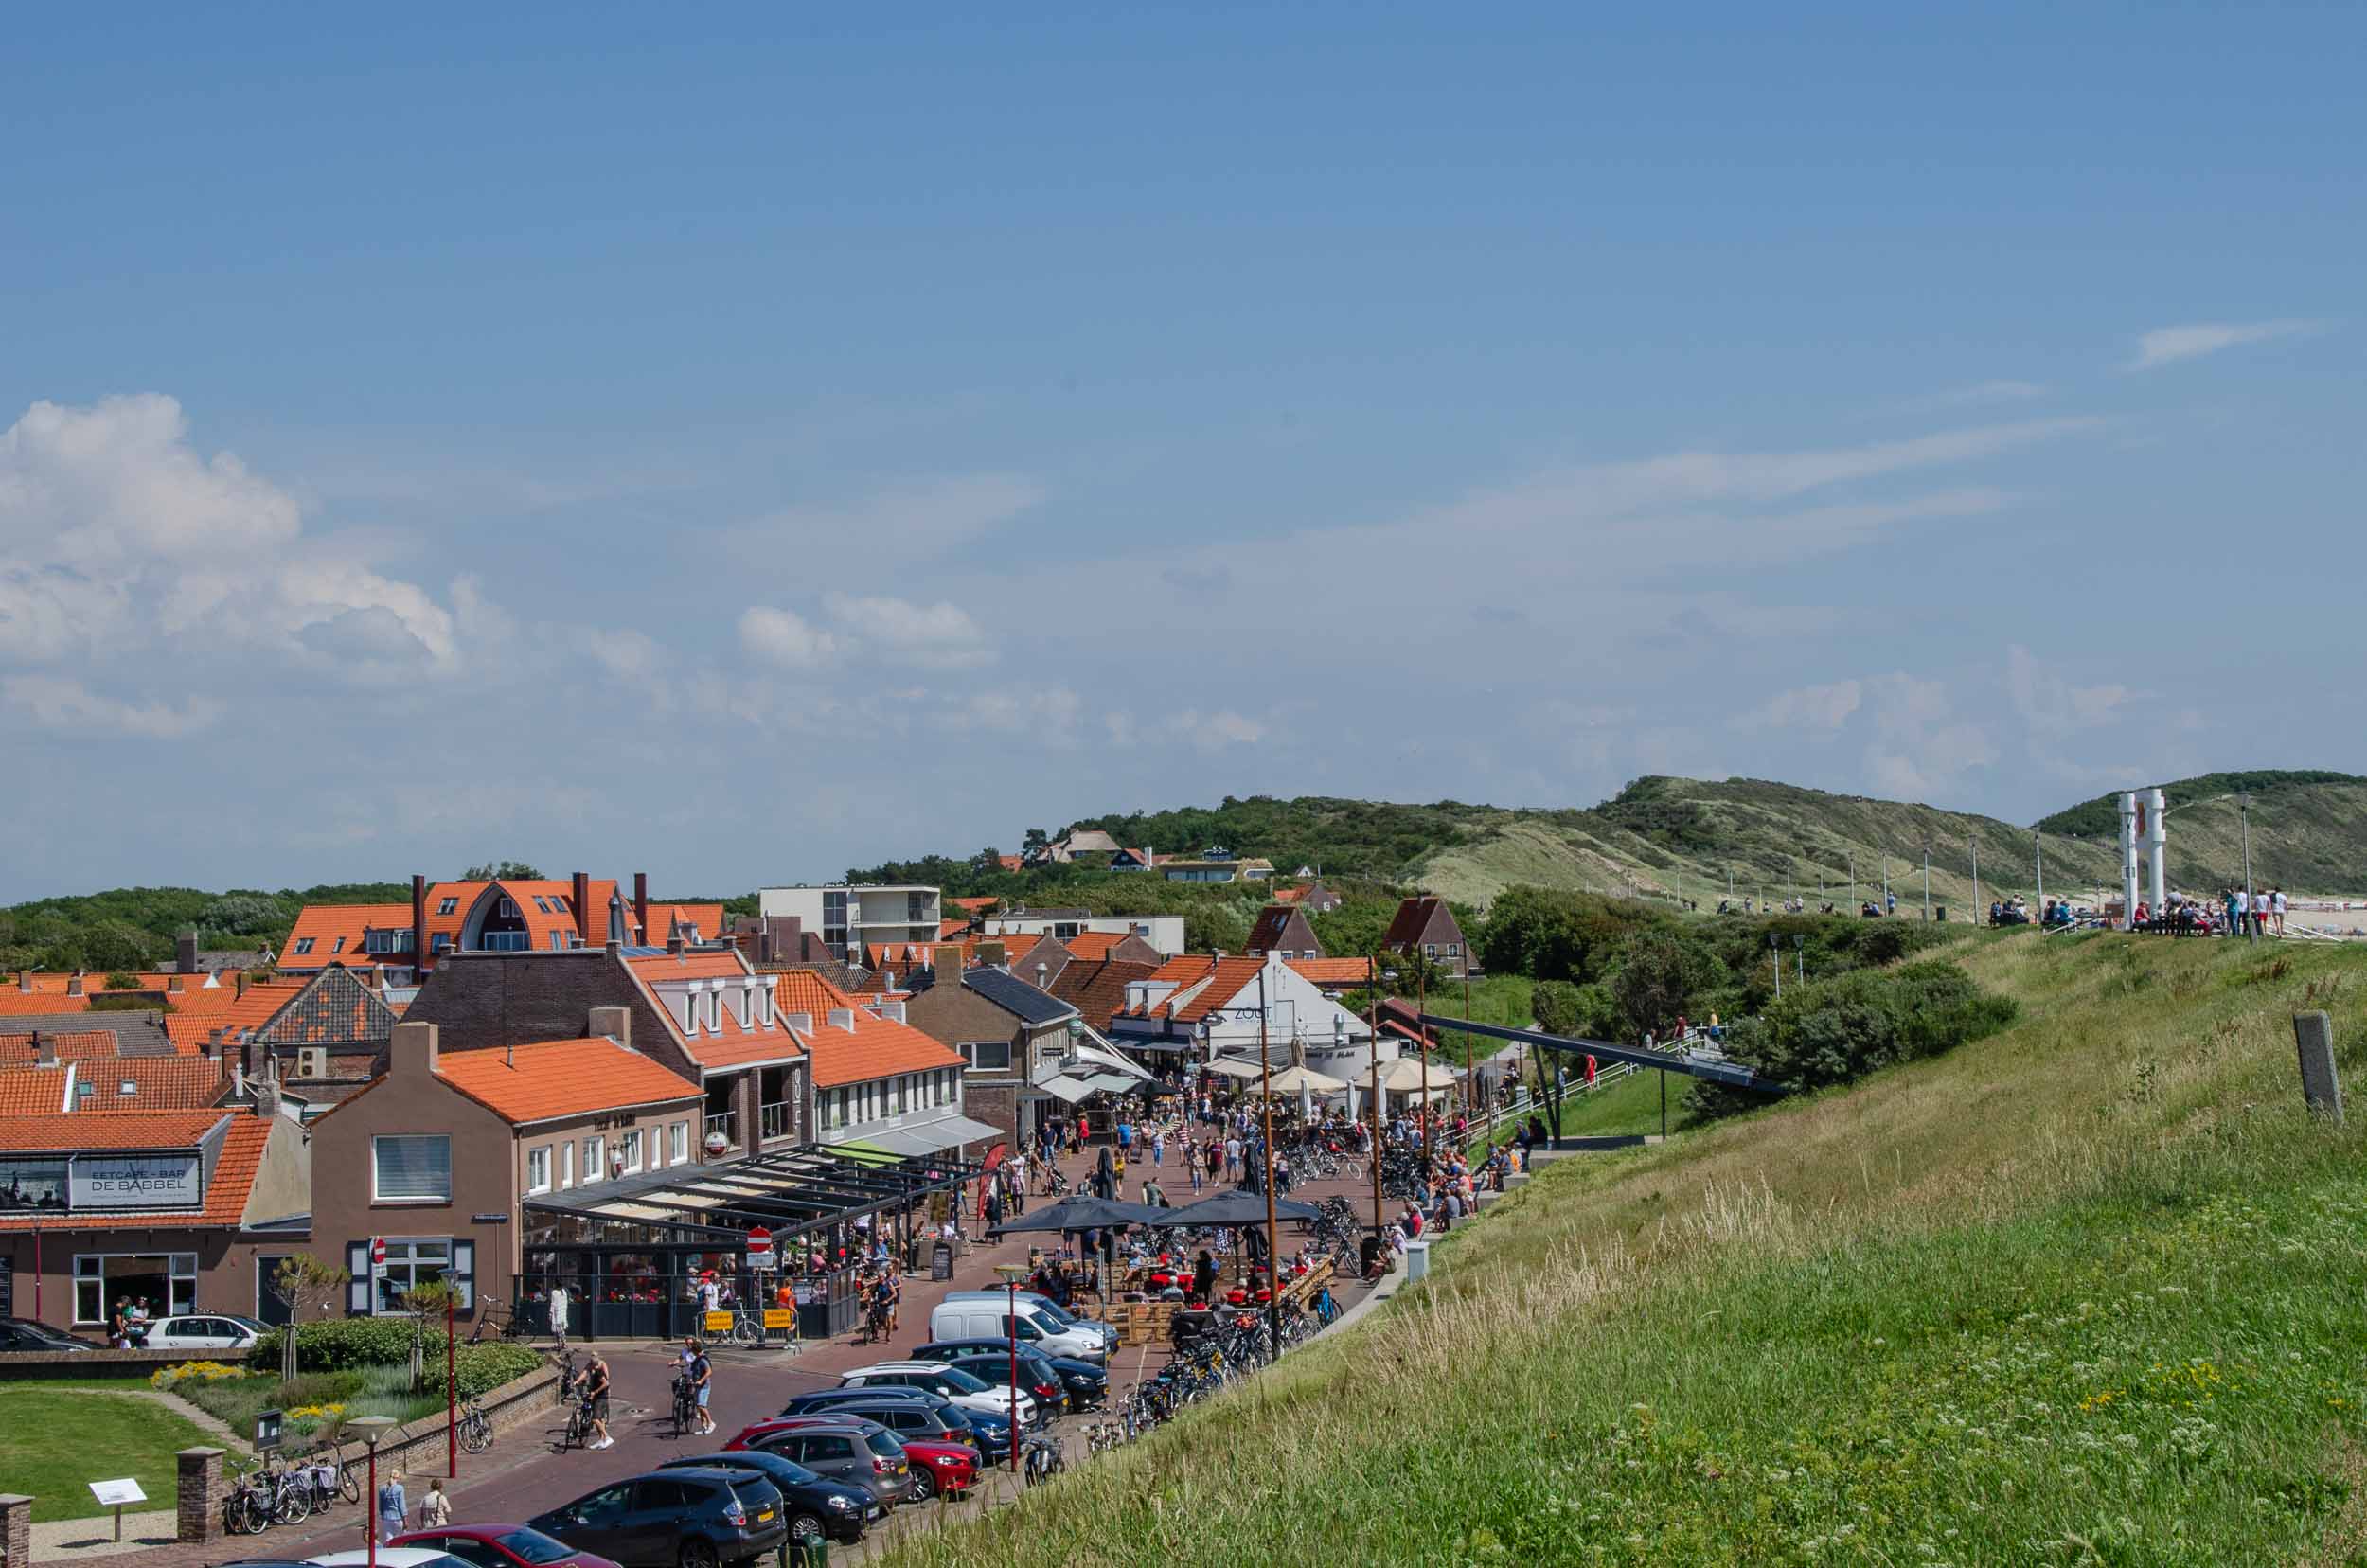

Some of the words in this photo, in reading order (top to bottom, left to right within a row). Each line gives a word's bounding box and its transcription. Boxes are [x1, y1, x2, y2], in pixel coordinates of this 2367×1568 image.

[159, 1169, 186, 1179] BAR
[92, 1181, 115, 1191] DE
[118, 1179, 187, 1193] BABBEL
